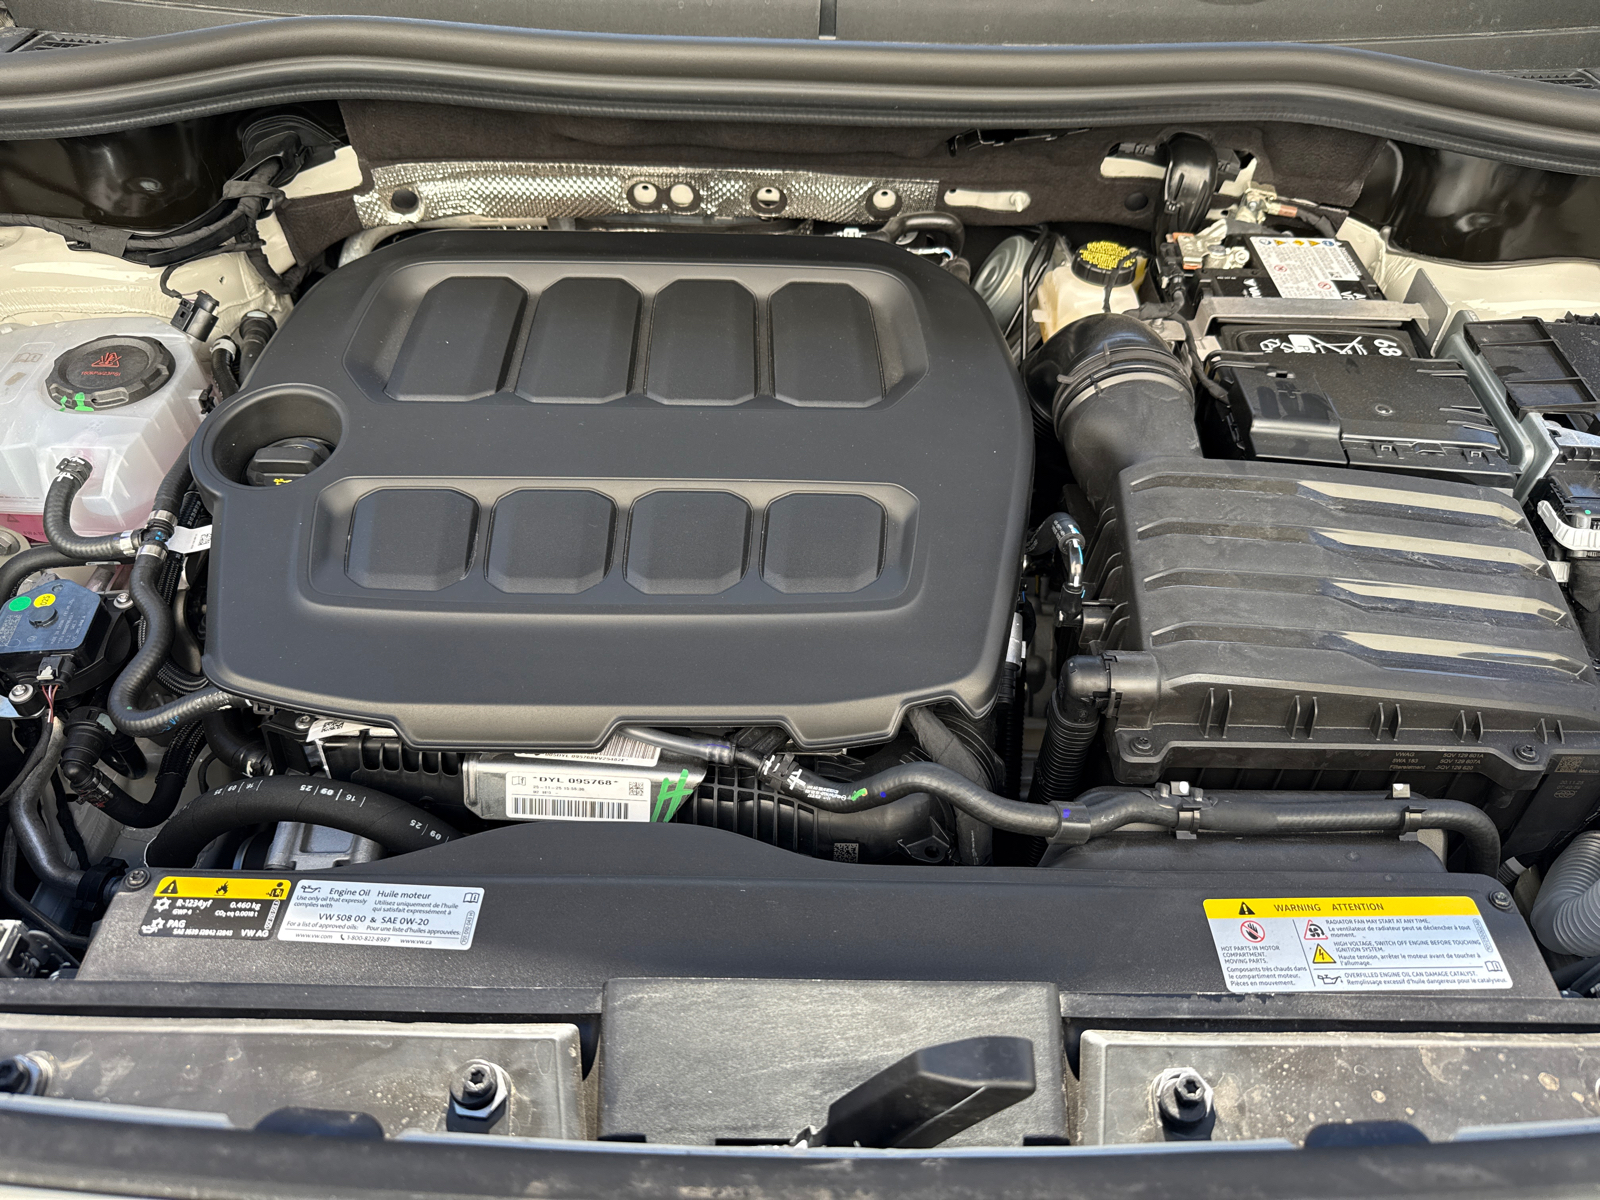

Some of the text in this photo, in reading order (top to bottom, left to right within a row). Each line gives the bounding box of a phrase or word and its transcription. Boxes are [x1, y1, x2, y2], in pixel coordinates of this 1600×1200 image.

[329, 888, 357, 897] Engine
[176, 899, 213, 909] R-1234yf
[252, 902, 261, 910] kg
[166, 920, 186, 928] PAG
[400, 917, 430, 926] 0W-20
